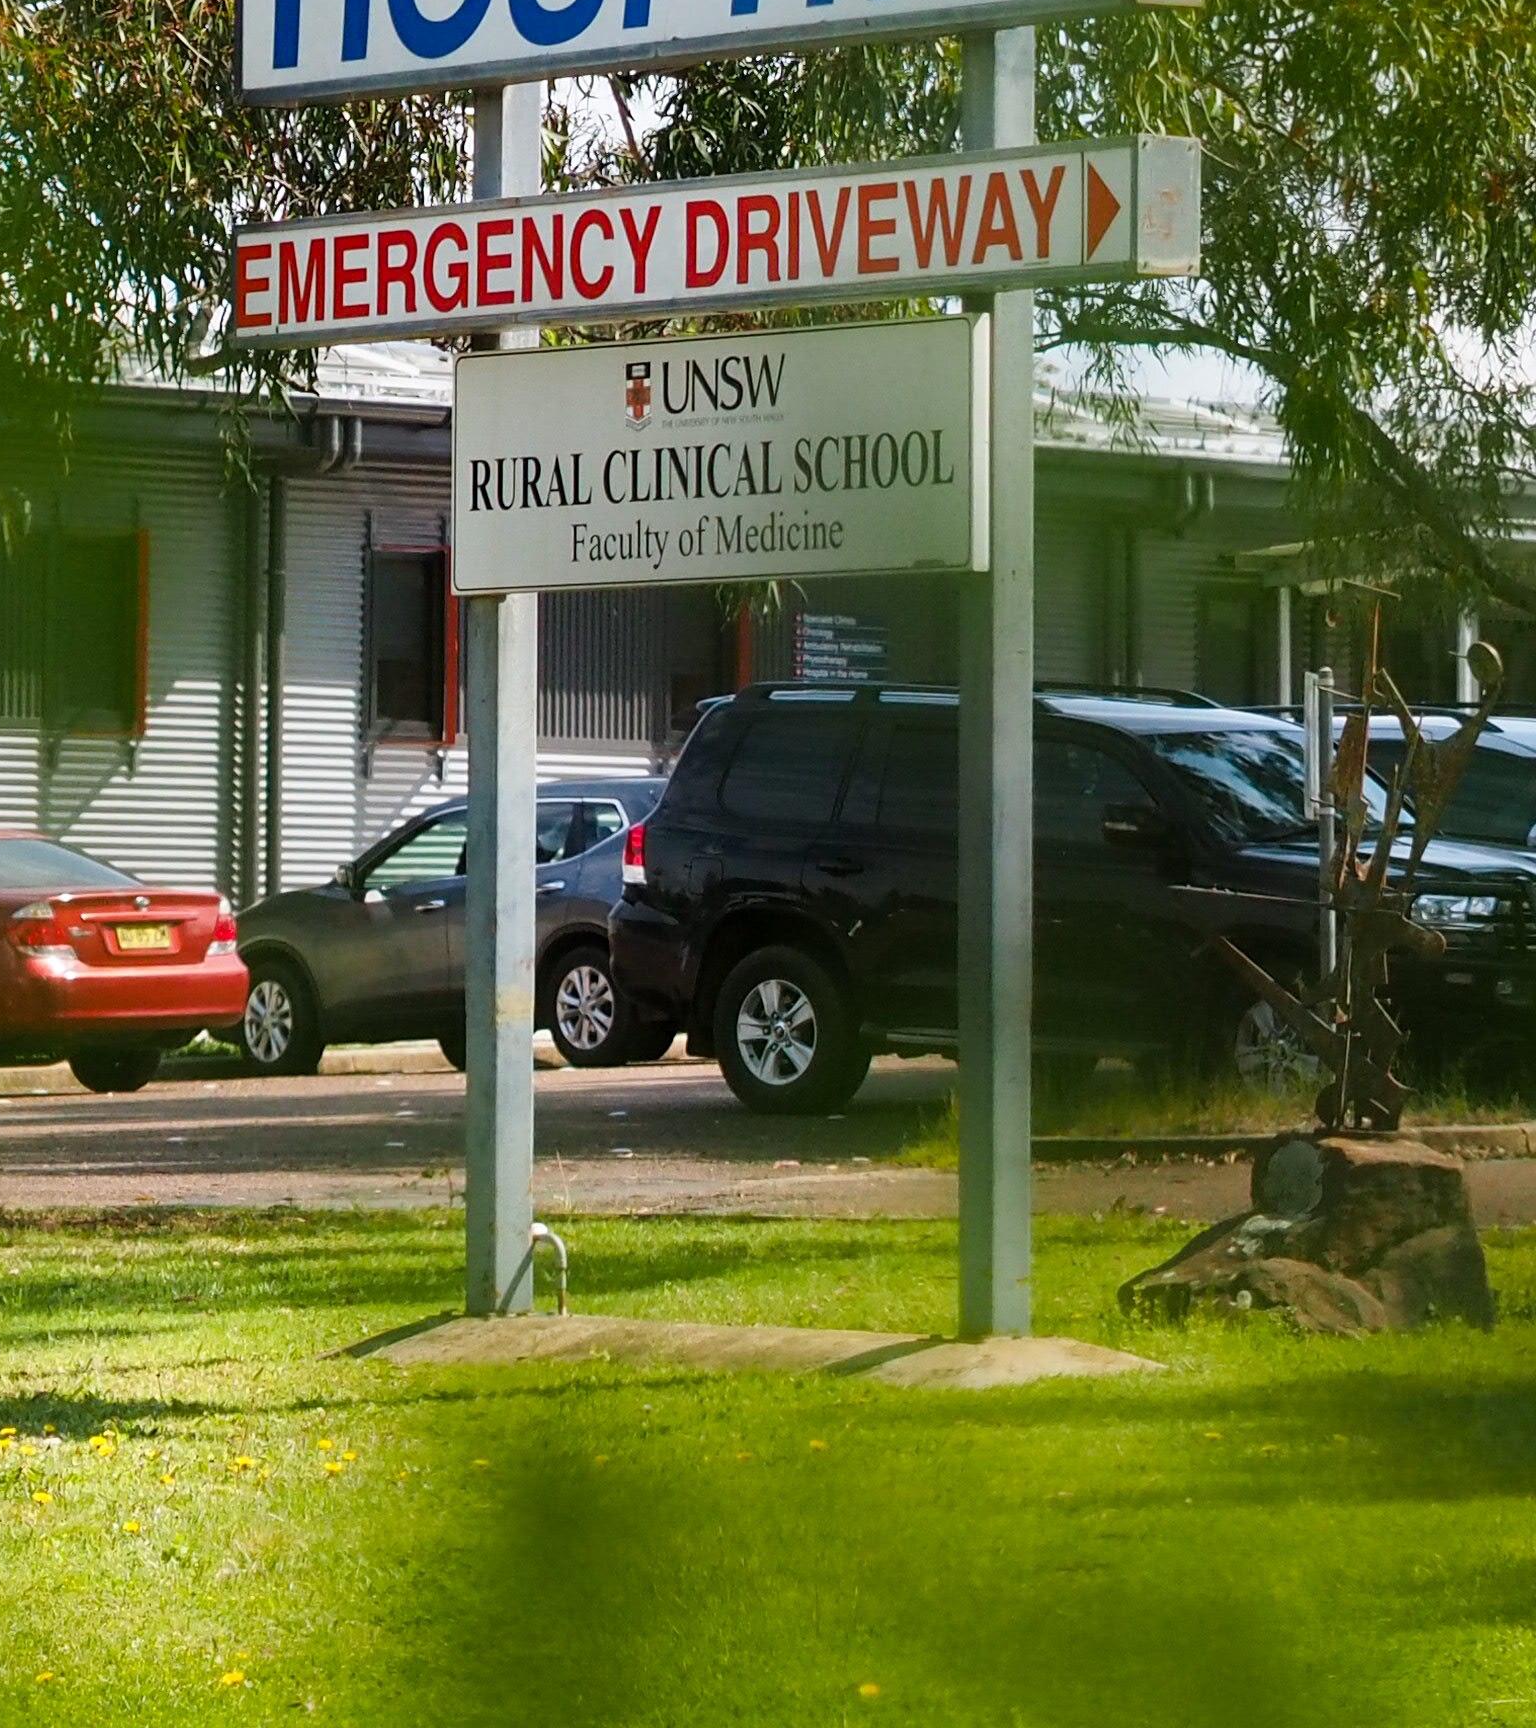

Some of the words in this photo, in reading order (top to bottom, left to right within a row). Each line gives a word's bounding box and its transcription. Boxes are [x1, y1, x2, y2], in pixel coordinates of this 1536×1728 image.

[235, 205, 661, 329] EMERGENCY
[686, 166, 1066, 288] DRIVEWAY
[662, 353, 785, 414] UNSW
[470, 453, 593, 512] RURAL
[603, 440, 783, 504] CLINICAL
[793, 429, 954, 494] SCHOOL
[571, 519, 670, 570] Faculty
[679, 515, 709, 557] of
[715, 512, 845, 556] Medicine
